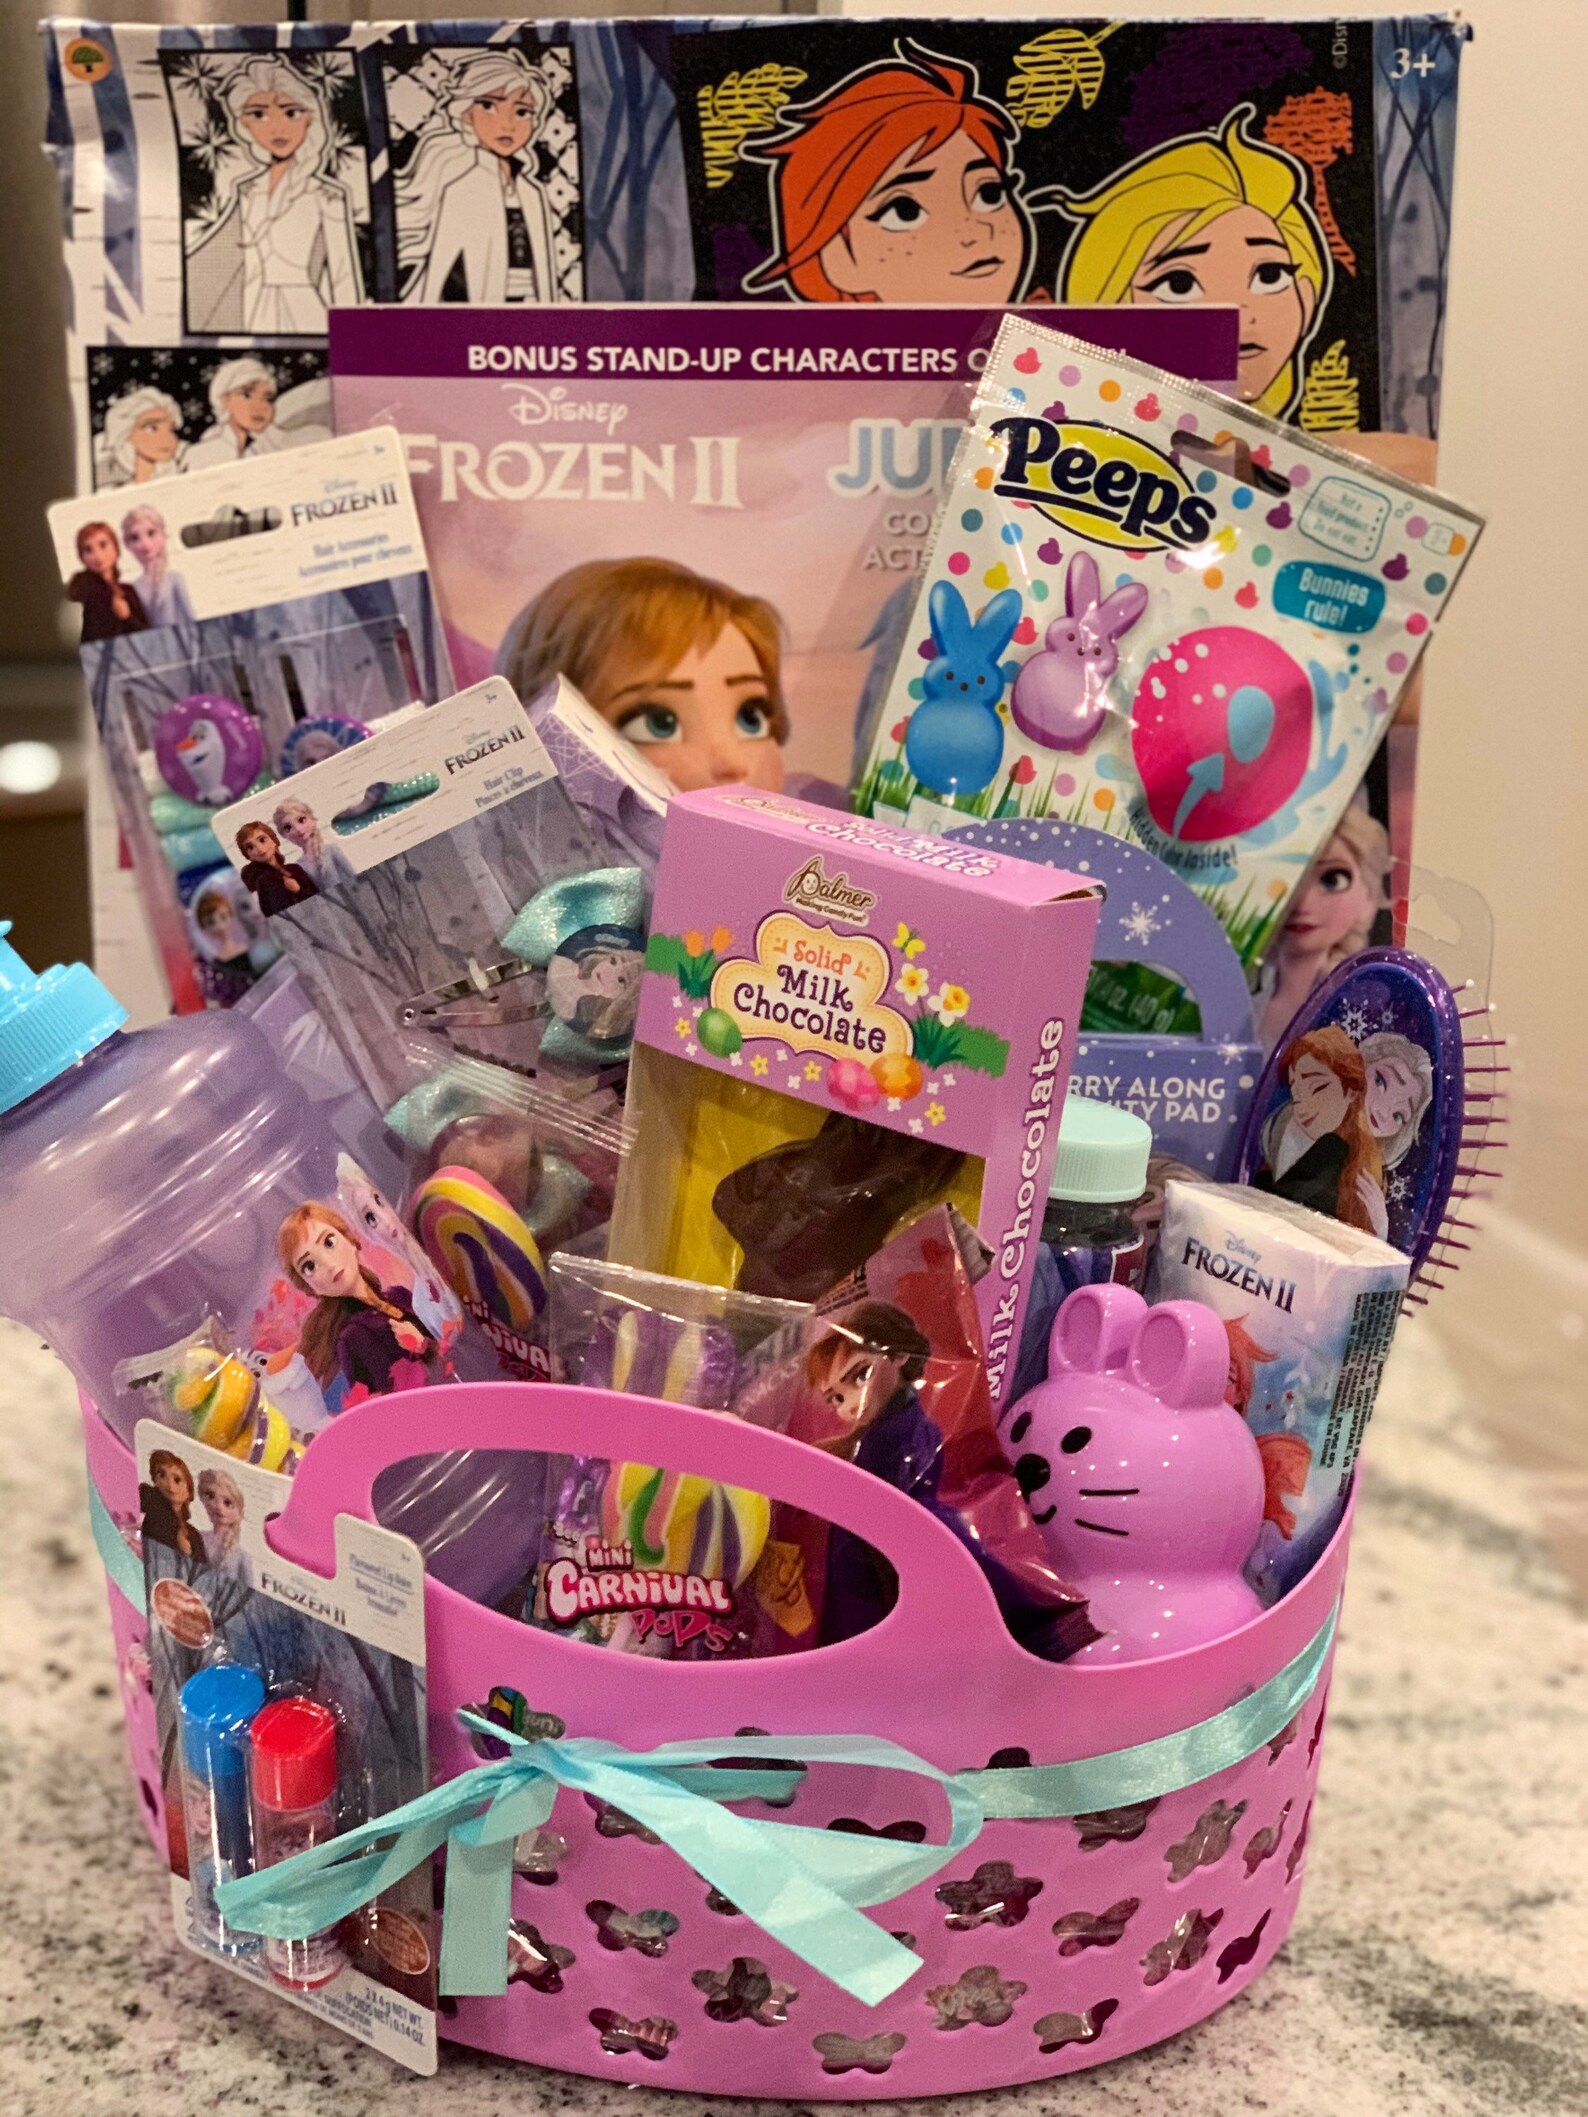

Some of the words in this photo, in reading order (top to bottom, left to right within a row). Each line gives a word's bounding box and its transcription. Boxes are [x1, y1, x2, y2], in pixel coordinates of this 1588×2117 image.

[1390, 48, 1436, 79] 3+
[467, 345, 578, 372] BONUS
[586, 346, 742, 373] STAND-UP
[750, 346, 957, 374] CHARACTERS
[399, 433, 677, 503] FROZEN
[688, 436, 745, 509] II
[990, 416, 1218, 544] Peeps
[290, 489, 378, 528] FROZEN
[379, 481, 398, 506] II
[1298, 566, 1370, 607] Bunnies
[1303, 598, 1349, 627] rule!
[443, 735, 511, 776] FROZEN
[510, 723, 527, 744] II
[806, 822, 994, 877] Chocolate
[911, 838, 1000, 869] Milk
[786, 855, 872, 908] Palmer
[793, 939, 852, 976] Solid
[776, 964, 854, 1013] Milk
[733, 982, 887, 1054] Chocolate
[1067, 1074, 1121, 1097] RRY
[1126, 1076, 1226, 1101] ALONG
[1164, 1101, 1221, 1123] PAD
[999, 1019, 1064, 1279] Chocolate
[1181, 1236, 1274, 1301] FROZEN
[1274, 1279, 1297, 1314] II
[985, 1283, 1020, 1400] Milk
[260, 1571, 331, 1618] FROZEN
